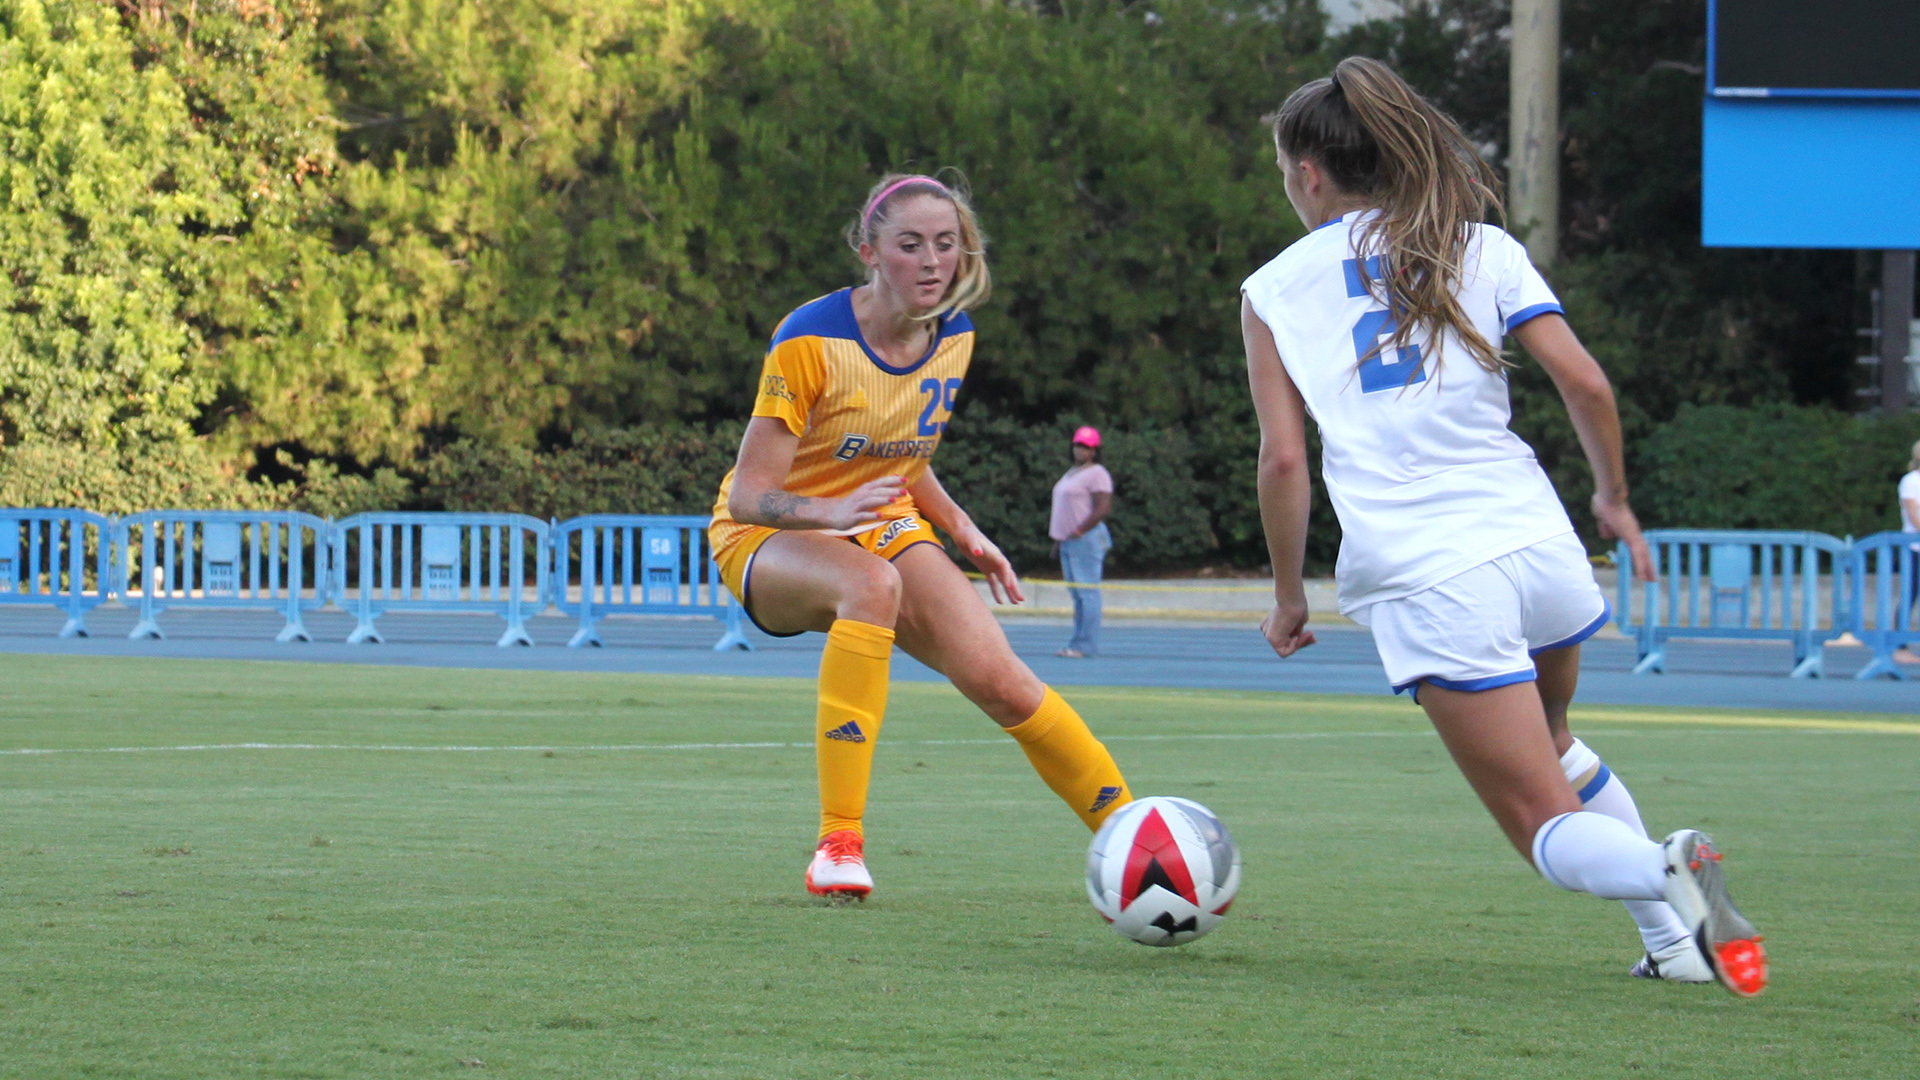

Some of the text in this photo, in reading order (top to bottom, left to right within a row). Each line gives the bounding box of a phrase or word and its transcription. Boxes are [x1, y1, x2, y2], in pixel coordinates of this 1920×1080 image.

[1342, 253, 1427, 394] 2
[832, 432, 935, 462] BAKERSFIE
[651, 538, 671, 555] 58
[876, 517, 919, 549] WAC
[825, 731, 866, 743] adidas
